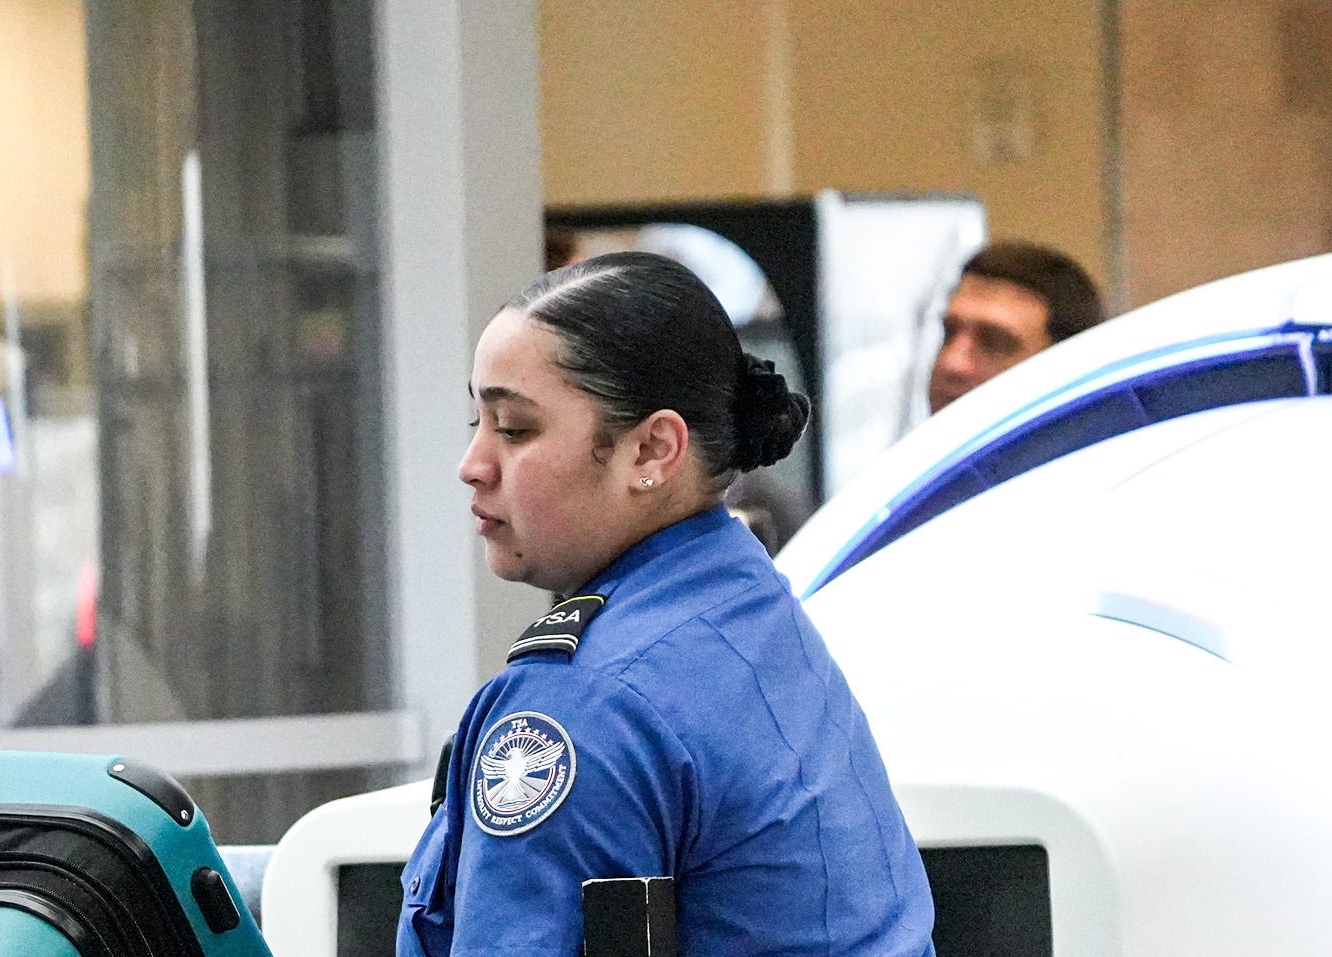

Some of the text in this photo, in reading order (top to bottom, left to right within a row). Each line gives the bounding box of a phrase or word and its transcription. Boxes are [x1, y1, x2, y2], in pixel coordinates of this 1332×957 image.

[534, 609, 580, 628] TSA
[511, 718, 528, 729] TSA
[491, 814, 523, 826] RESPECT
[525, 764, 567, 818] COMMITMENT
